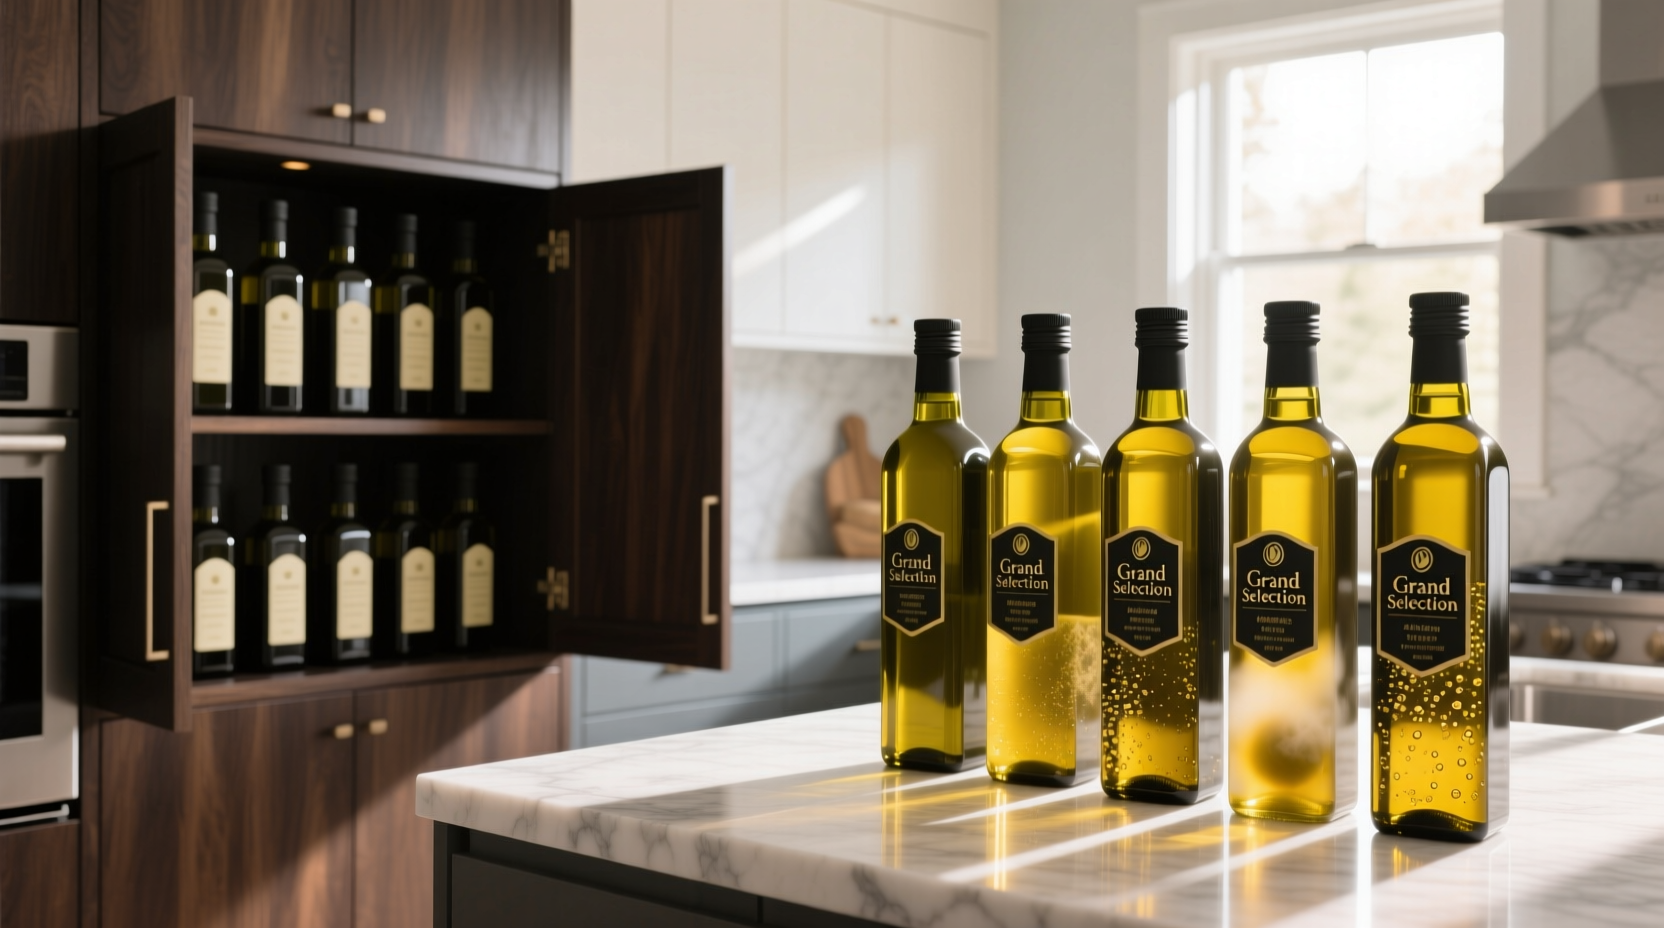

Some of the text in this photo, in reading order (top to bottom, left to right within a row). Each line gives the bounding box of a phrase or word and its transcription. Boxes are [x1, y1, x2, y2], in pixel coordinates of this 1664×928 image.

[1000, 558, 1044, 575] Grand
[1117, 563, 1166, 581] Grand
[1247, 570, 1300, 589] Grand
[1393, 575, 1450, 595] Grand
[1242, 588, 1306, 605] Selection
[1387, 594, 1458, 611] Selection
